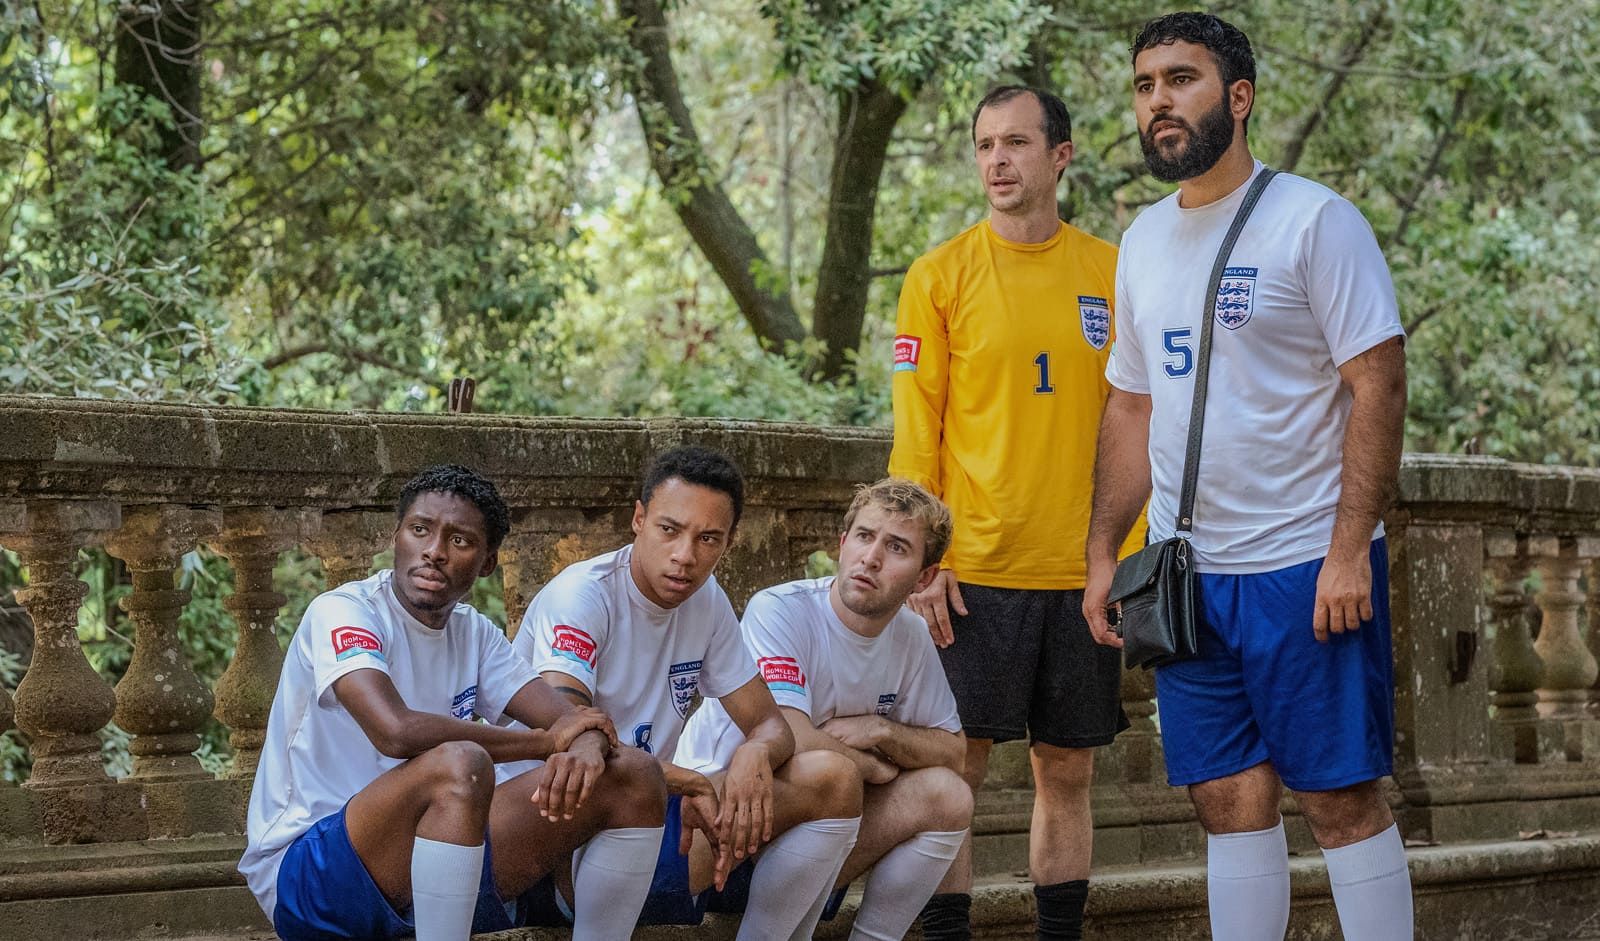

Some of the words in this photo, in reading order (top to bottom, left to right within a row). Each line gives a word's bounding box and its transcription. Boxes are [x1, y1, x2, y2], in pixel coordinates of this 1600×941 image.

[1033, 351, 1055, 395] 1
[1162, 327, 1195, 379] 5
[671, 662, 701, 672] ENGLAND
